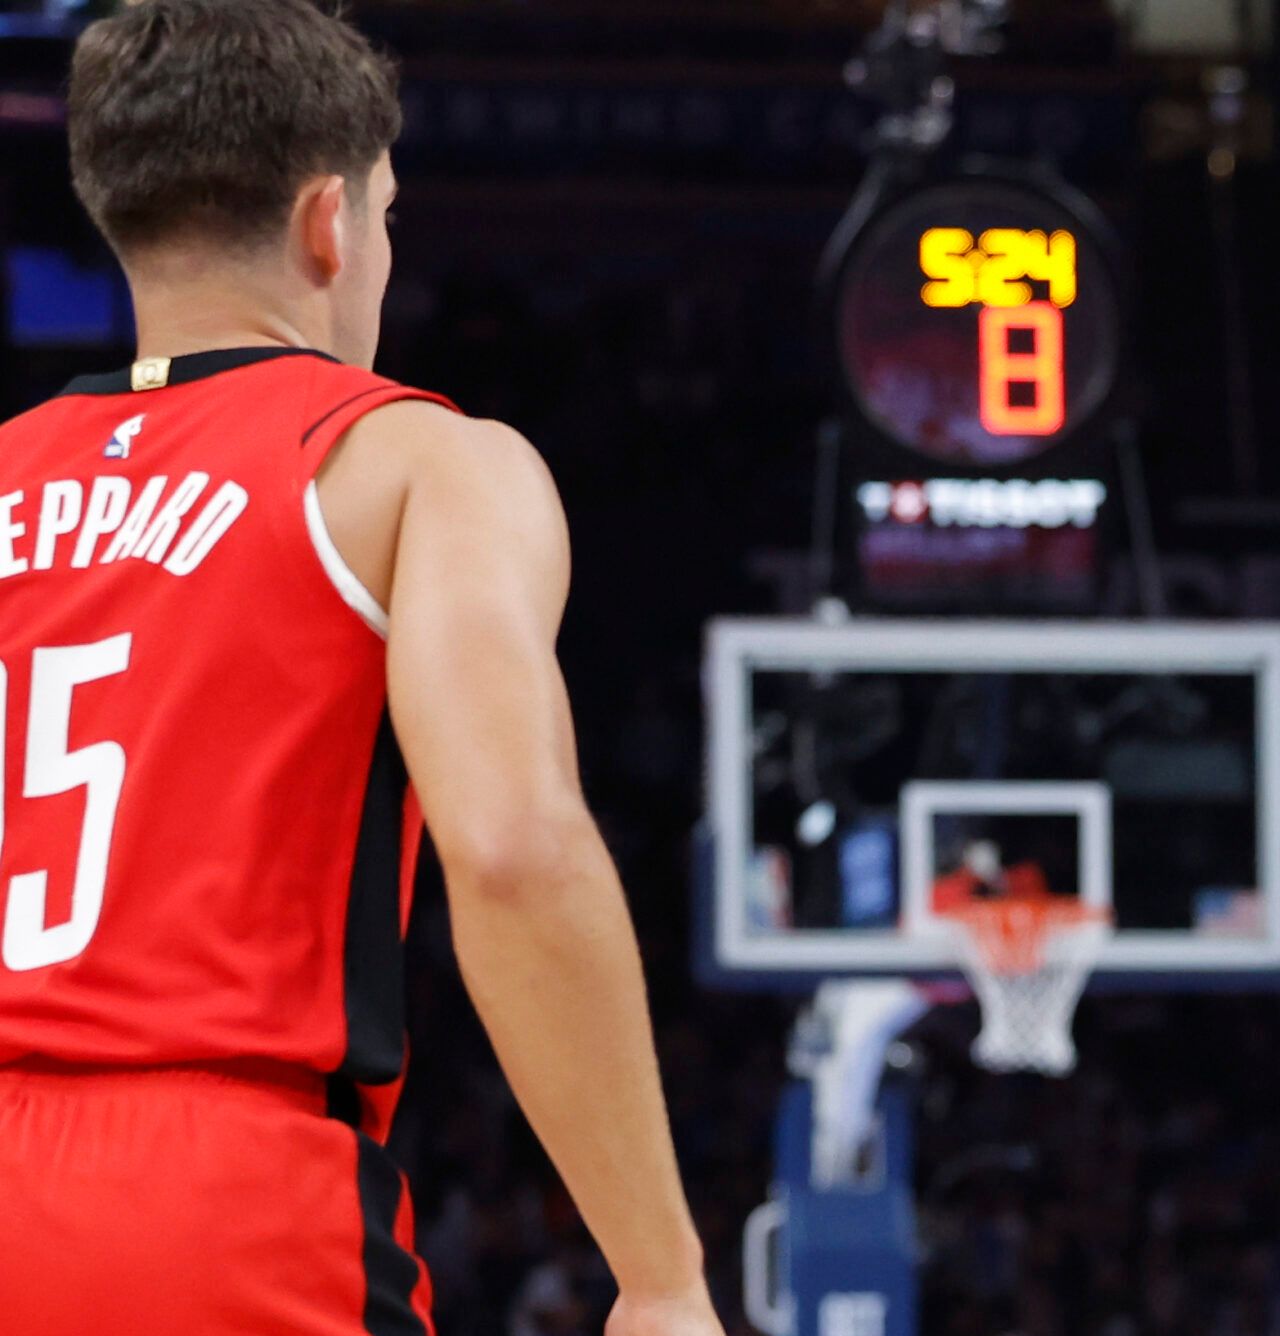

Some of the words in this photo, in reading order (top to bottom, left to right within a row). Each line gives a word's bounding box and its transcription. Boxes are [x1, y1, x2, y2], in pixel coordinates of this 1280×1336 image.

[979, 300, 1065, 436] 8
[0, 471, 249, 579] EPPARD
[0, 633, 131, 972] 5
